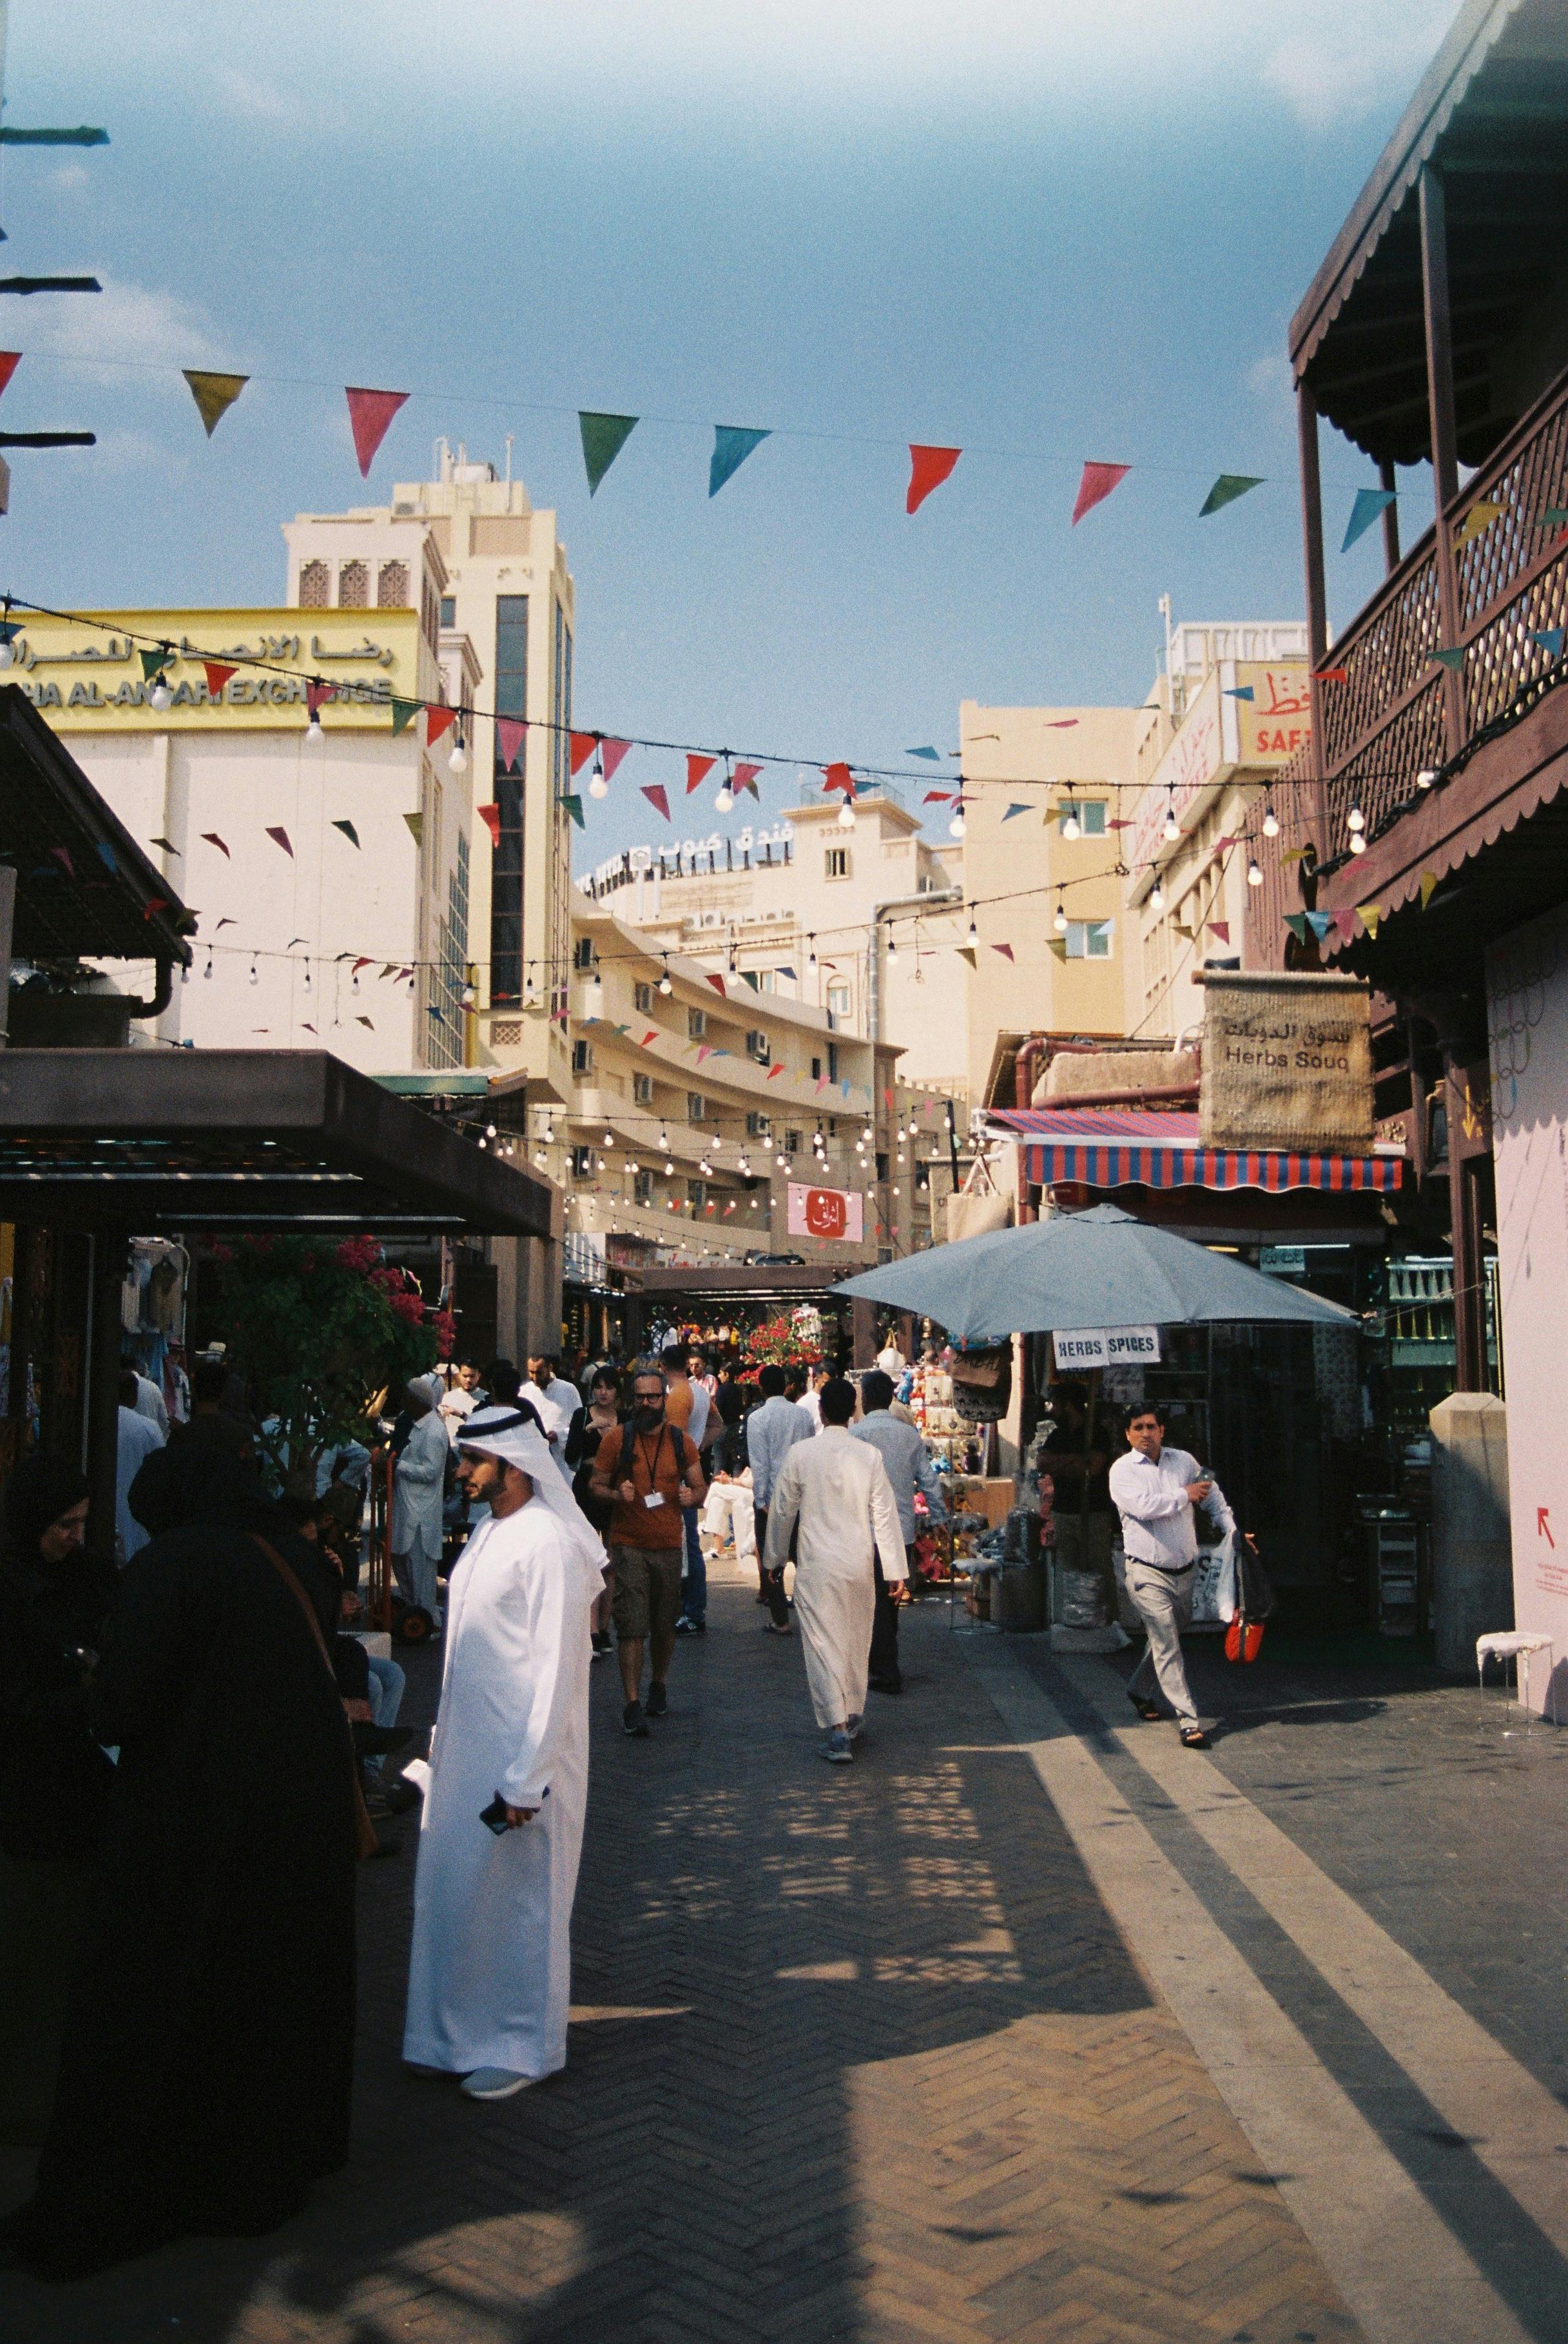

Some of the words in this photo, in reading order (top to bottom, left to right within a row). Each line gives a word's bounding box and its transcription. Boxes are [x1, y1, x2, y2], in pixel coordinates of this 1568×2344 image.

[68, 681, 222, 706] AL-ANARI
[228, 679, 392, 705] EXCHNGE
[1257, 730, 1313, 753] SAF
[1226, 1046, 1288, 1067] Herbs
[1295, 1051, 1350, 1072] Souq
[1058, 1341, 1102, 1357] HERBS
[1108, 1337, 1154, 1353] SPICES
